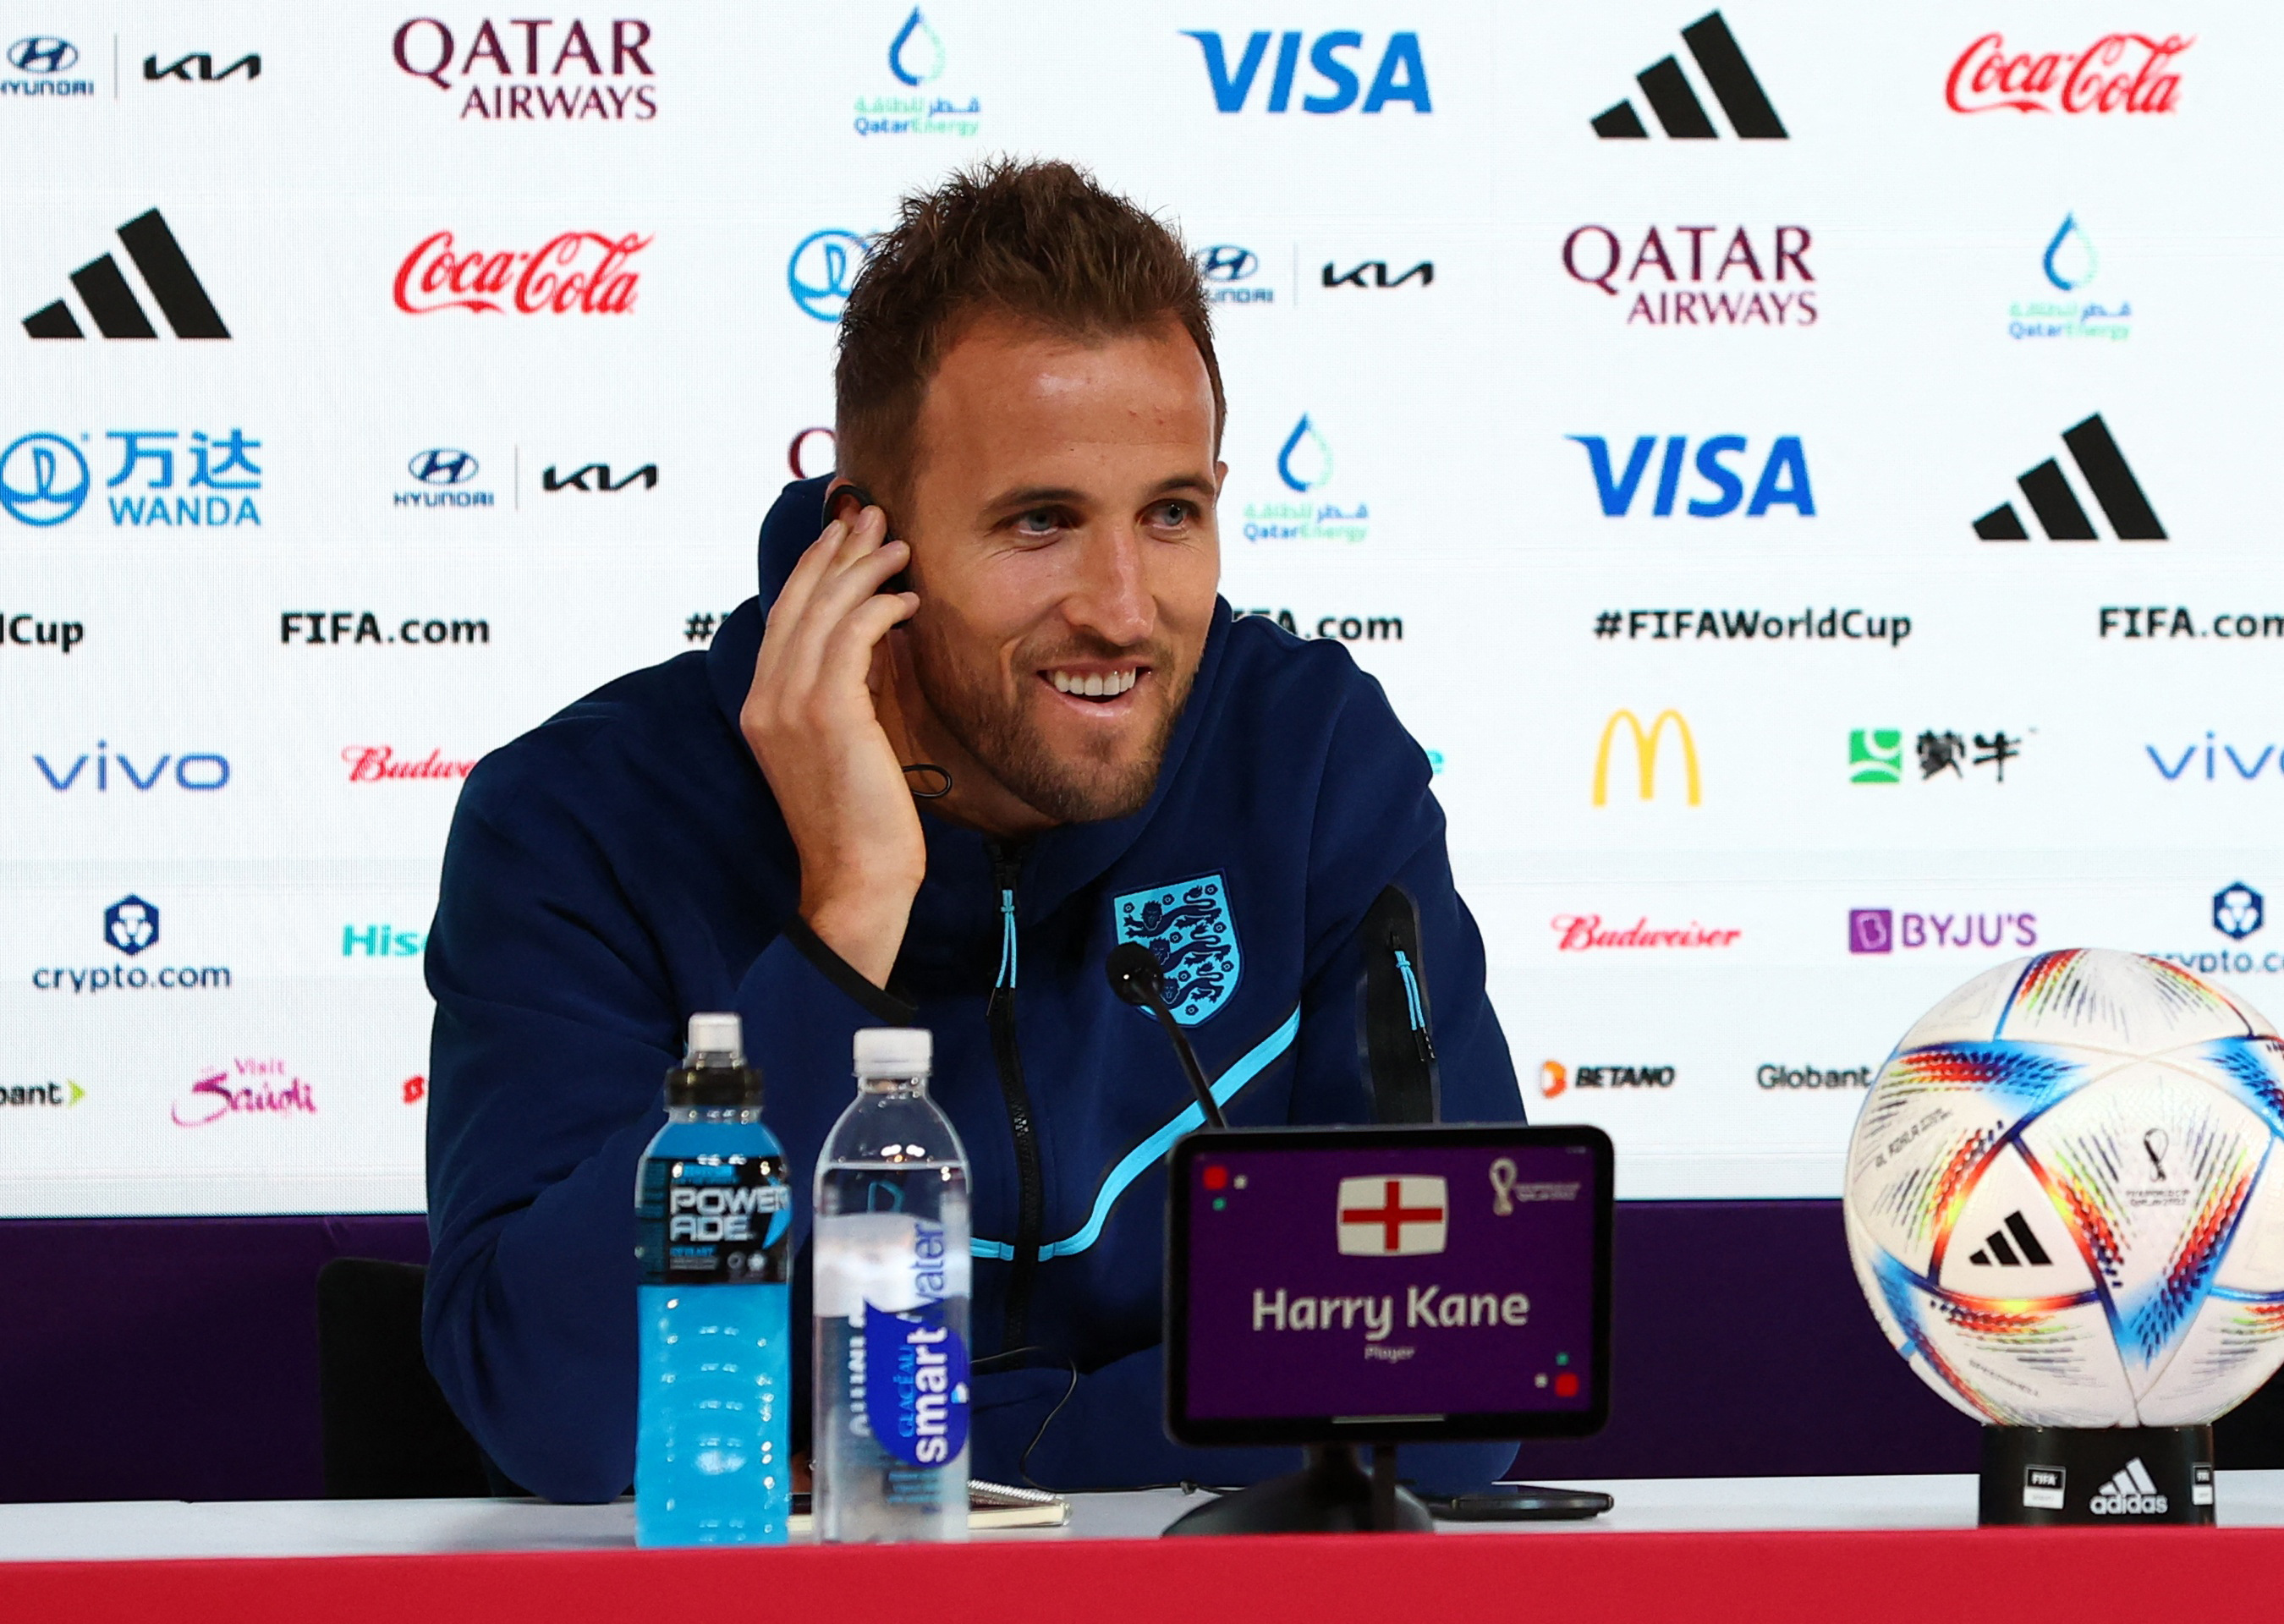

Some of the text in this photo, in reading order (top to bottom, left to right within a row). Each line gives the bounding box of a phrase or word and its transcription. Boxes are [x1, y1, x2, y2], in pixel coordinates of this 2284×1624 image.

[393, 18, 655, 91] QATAR
[1181, 30, 1433, 114] VISA
[1945, 32, 2196, 114] Coca-Cola
[461, 86, 656, 120] AIRWAYS
[393, 231, 653, 314] Coca-Cola
[1562, 225, 1815, 295] QATAR
[1628, 293, 1818, 325] AIRWAYS
[106, 429, 261, 490] 万达
[1565, 434, 1817, 518] VISA
[108, 496, 261, 527] WANDA
[393, 491, 494, 508] HYUNDAI
[281, 612, 490, 644] FIFA.com
[1594, 607, 1913, 647] #FIFAWorldCup
[33, 739, 230, 792] vivo
[2146, 731, 2284, 780] viv
[1551, 914, 1741, 951] Budweiser
[1902, 913, 2037, 948] BYJU'S
[32, 963, 231, 994] crypto.com
[234, 1058, 285, 1075] Visit
[1575, 1066, 1676, 1089] BETANO
[1757, 1063, 1870, 1089] Globant
[172, 1071, 316, 1127] Saudi
[1253, 1285, 1529, 1341] Harry Kane
[1364, 1344, 1415, 1363] Player
[892, 1345, 915, 1438] GLACÉAU
[906, 1326, 948, 1463] smart
[2031, 1472, 2057, 1486] FIFA
[2089, 1492, 2168, 1515] adidas
